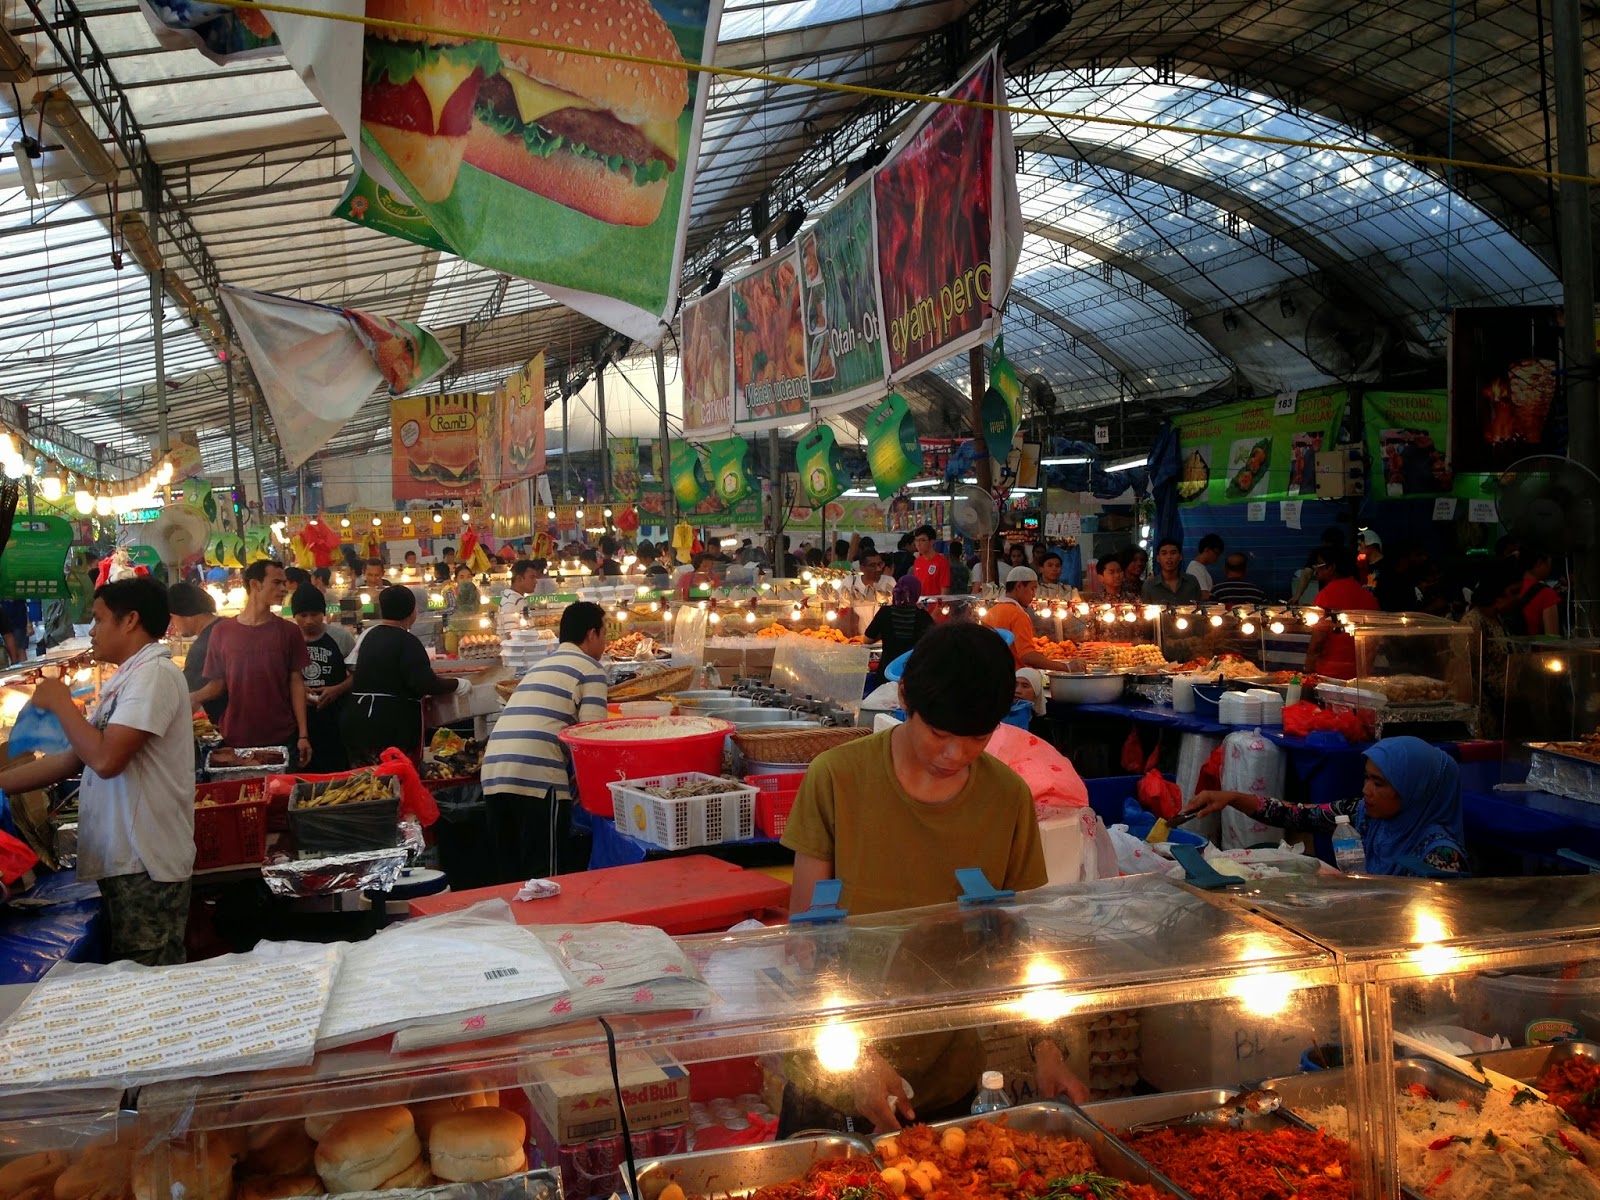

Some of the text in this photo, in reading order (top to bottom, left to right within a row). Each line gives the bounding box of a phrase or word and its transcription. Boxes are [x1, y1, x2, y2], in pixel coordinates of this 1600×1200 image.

[891, 295, 937, 358] ayam
[831, 322, 856, 357] Otah
[774, 374, 811, 403] udang
[1278, 398, 1292, 409] 183
[437, 414, 467, 431] Ramly
[322, 665, 332, 674] 57
[621, 1081, 678, 1106] Red Bull
[630, 1114, 651, 1123] CANS
